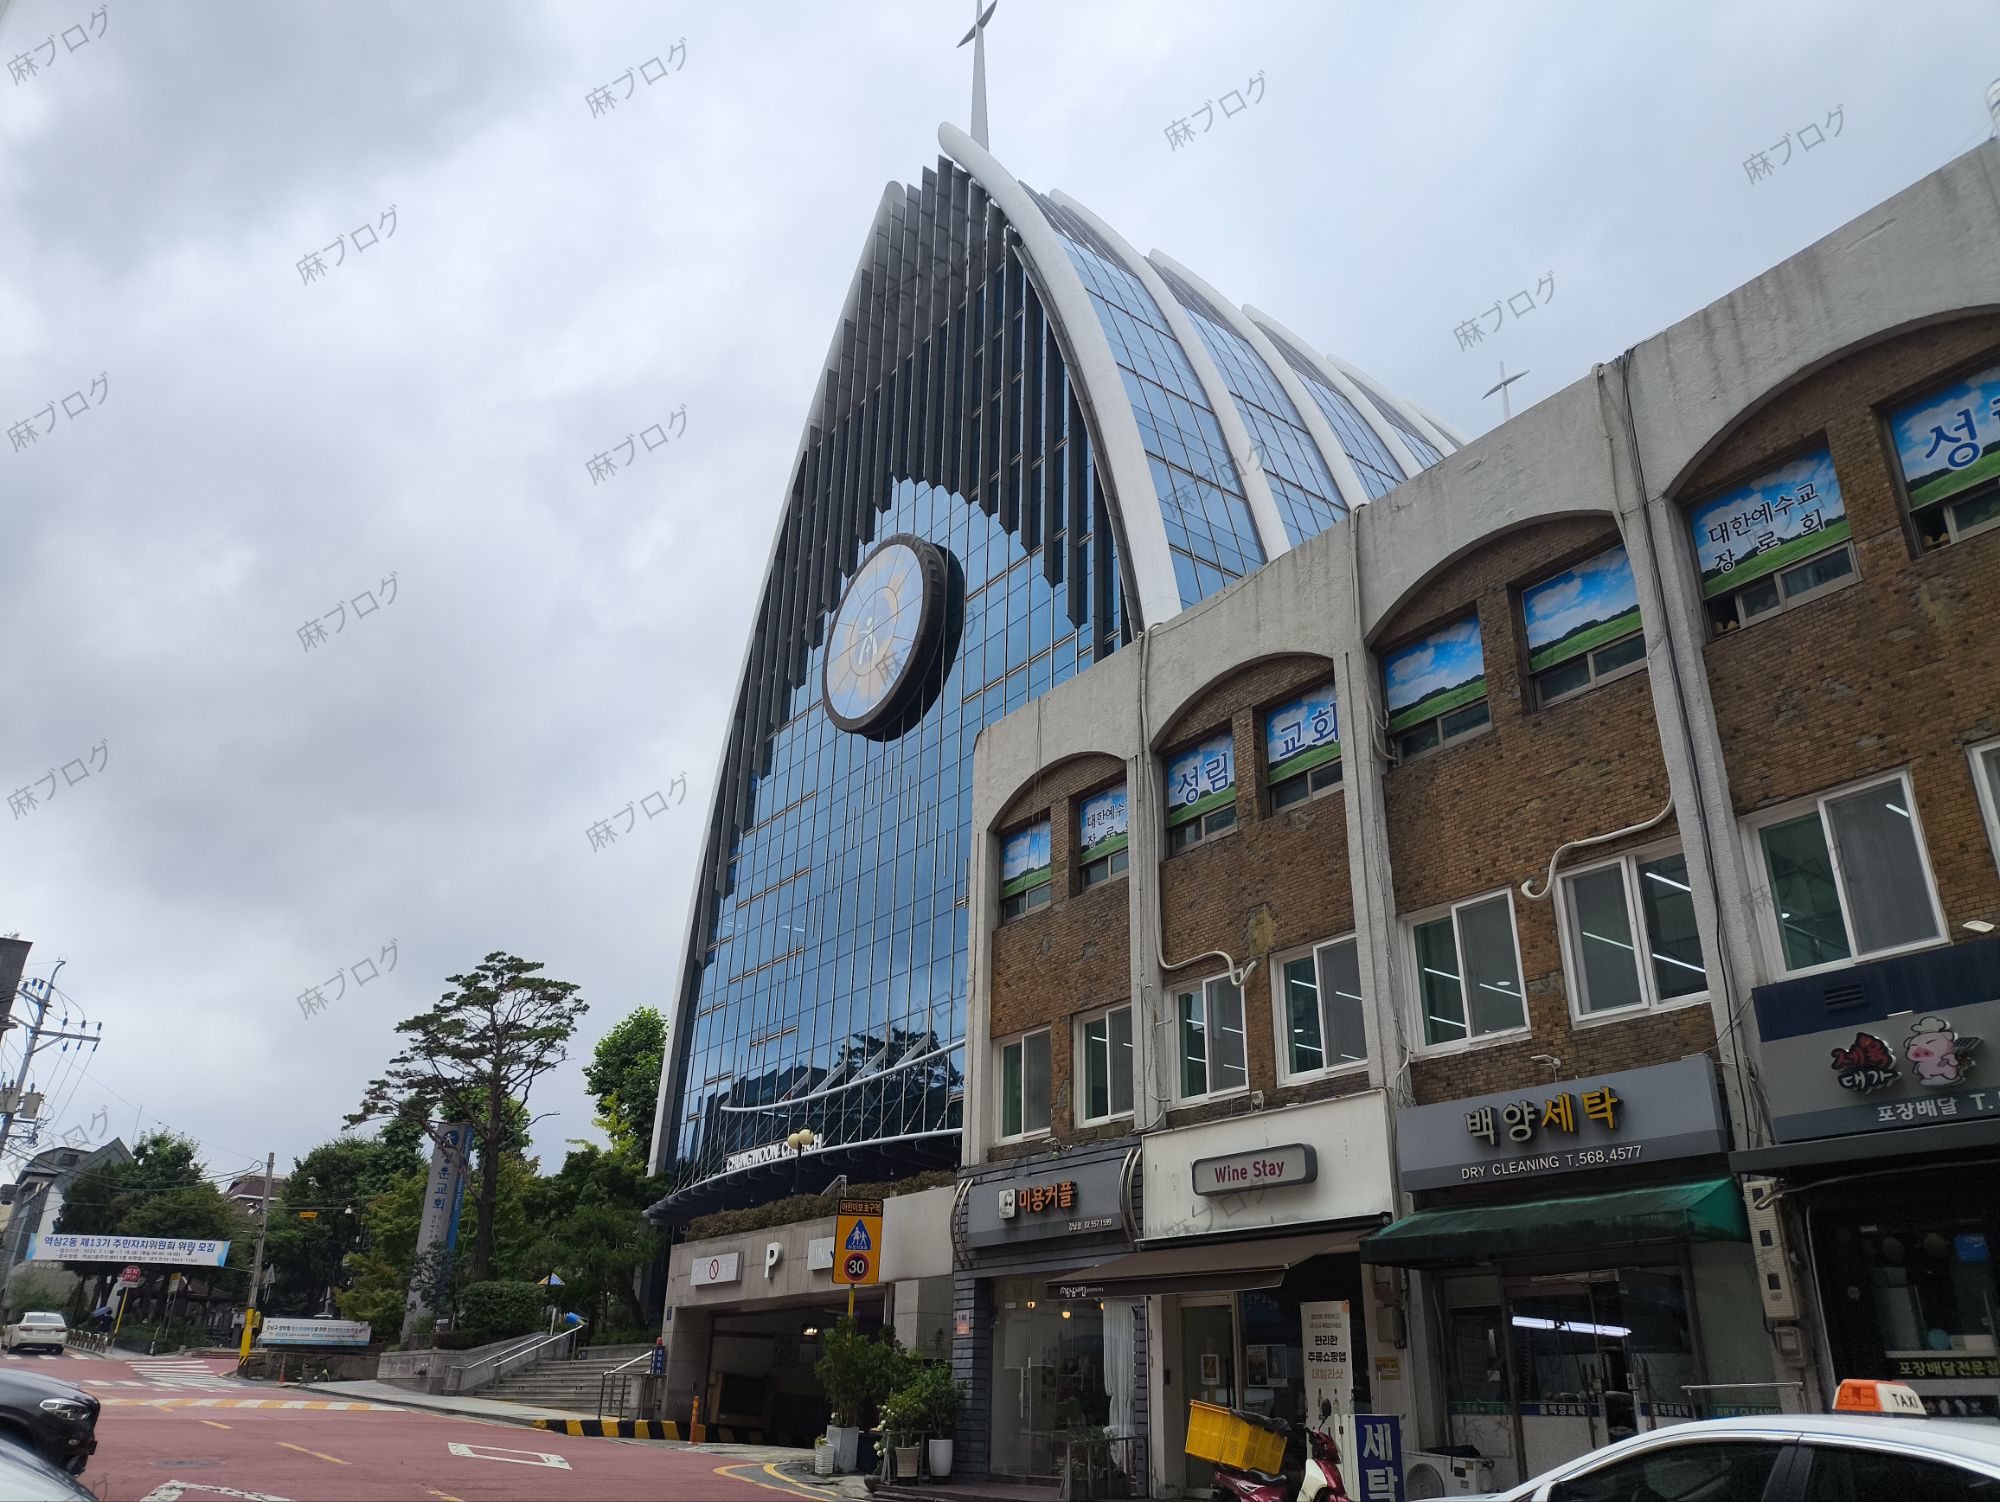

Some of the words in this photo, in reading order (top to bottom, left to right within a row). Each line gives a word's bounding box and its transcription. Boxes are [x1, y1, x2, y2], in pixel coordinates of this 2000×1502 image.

[1708, 482, 1819, 545] 대한예수교
[1178, 752, 1229, 804] 성림
[1279, 702, 1339, 757] 교회
[1464, 1086, 1620, 1145] 백양세탁
[1878, 1098, 1957, 1121] 포장배달
[1970, 1091, 2000, 1111] T.
[1215, 1165, 1248, 1184] Wine
[1253, 1159, 1285, 1178] Stay
[1461, 1166, 1486, 1180] DRY
[1492, 1156, 1560, 1176] CLEANING
[841, 1202, 881, 1213] 어린이보호구역
[1019, 1180, 1073, 1212] 미용커플
[44, 1236, 78, 1247] 역삼2동
[80, 1237, 110, 1248] 제13기
[113, 1238, 176, 1251] 주민자치위원회
[197, 1241, 216, 1253] 모집
[764, 1241, 783, 1279] P
[848, 1259, 865, 1275] 30
[1314, 1335, 1338, 1346] 편리한
[1308, 1352, 1347, 1363] 주류쇼핑앱
[1891, 1393, 1919, 1410] TAXI
